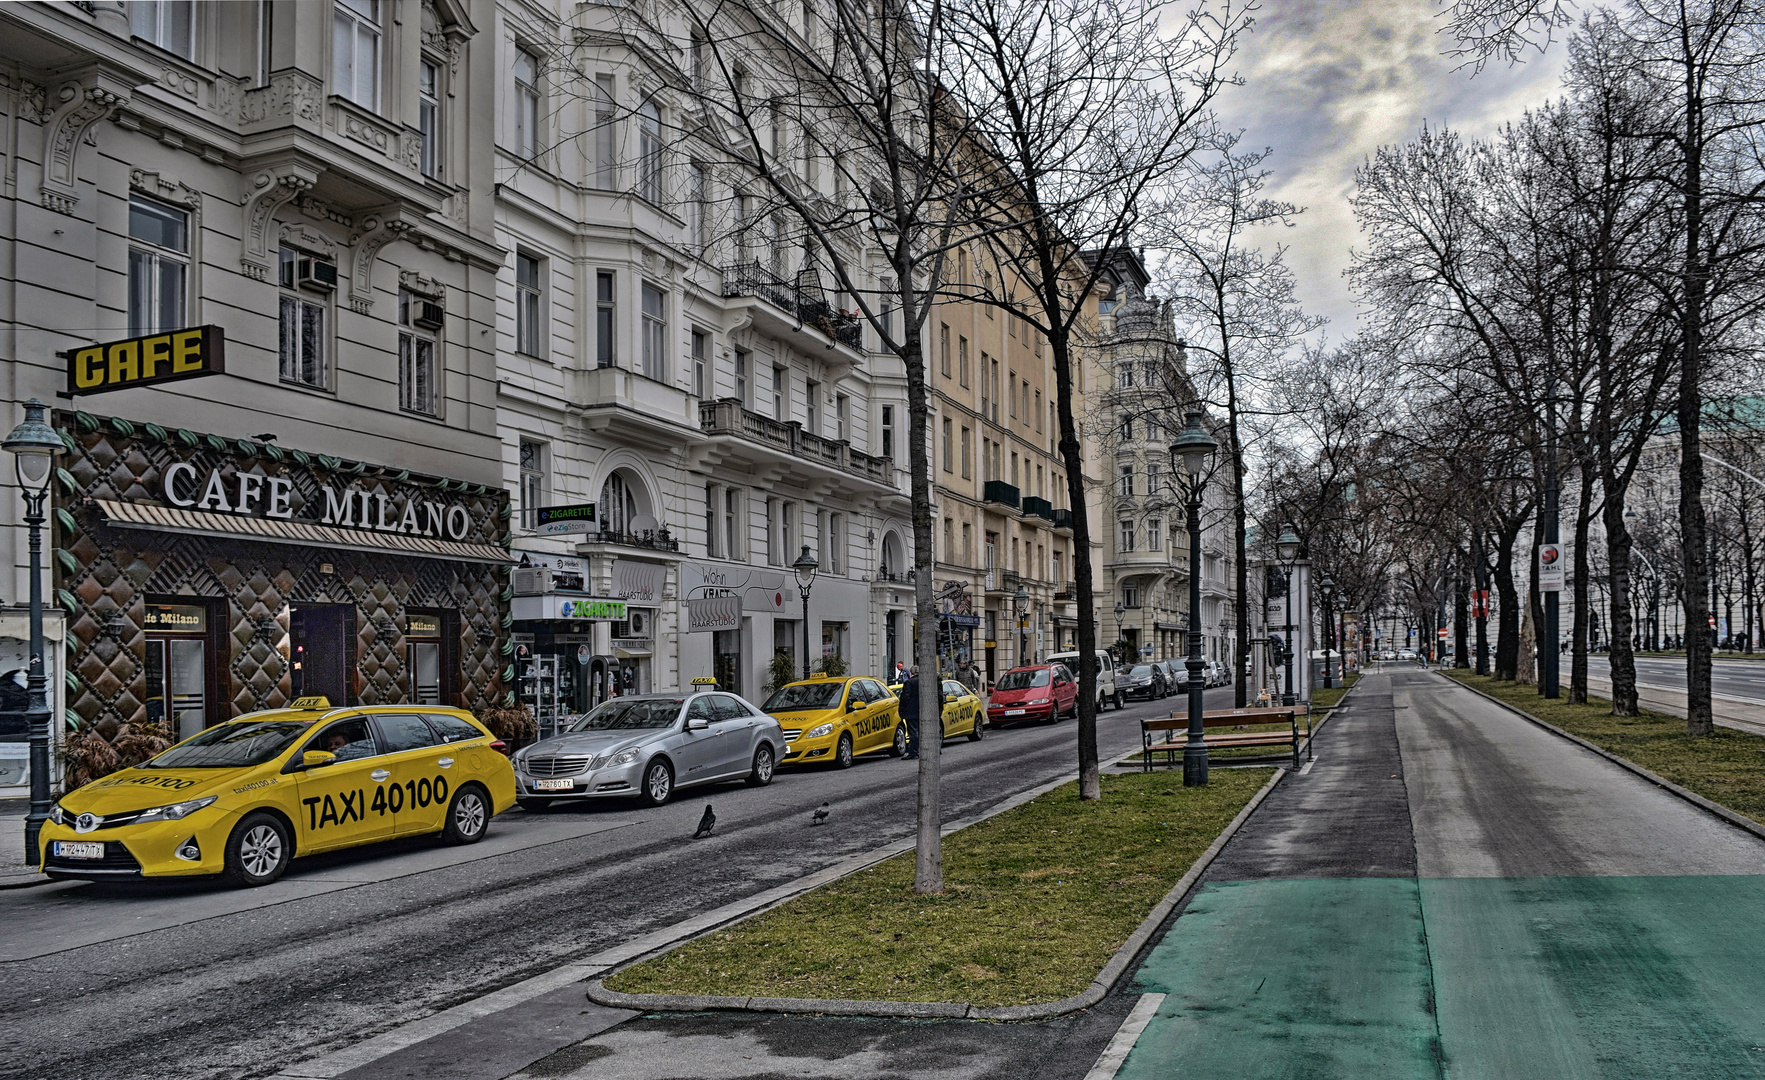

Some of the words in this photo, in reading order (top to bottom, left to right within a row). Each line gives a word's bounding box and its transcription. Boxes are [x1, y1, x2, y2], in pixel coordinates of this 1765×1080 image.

[75, 329, 203, 388] CAFE
[164, 462, 293, 519] CAFE
[321, 485, 469, 540] MILANO
[541, 507, 592, 519] e-ZIGARETTE
[554, 523, 586, 531] eZigStore
[702, 565, 727, 585] Wohn
[618, 590, 653, 601] HAARSTUDIO
[703, 588, 730, 600] KRAFT
[563, 601, 626, 618] e-ZIGARETTE
[144, 612, 157, 624] fe
[160, 613, 199, 625] Milano
[691, 618, 736, 628] HAARSTUDIO
[410, 621, 436, 631] Milano
[293, 698, 321, 707] TAXI
[947, 709, 959, 725] TAXI
[959, 705, 973, 721] 40100
[855, 718, 871, 738] TAXI
[872, 712, 891, 732] 40100
[131, 776, 195, 790] 40100
[232, 777, 279, 794] taxi40100.at
[302, 788, 365, 831] TAXI
[370, 774, 448, 817] 40100
